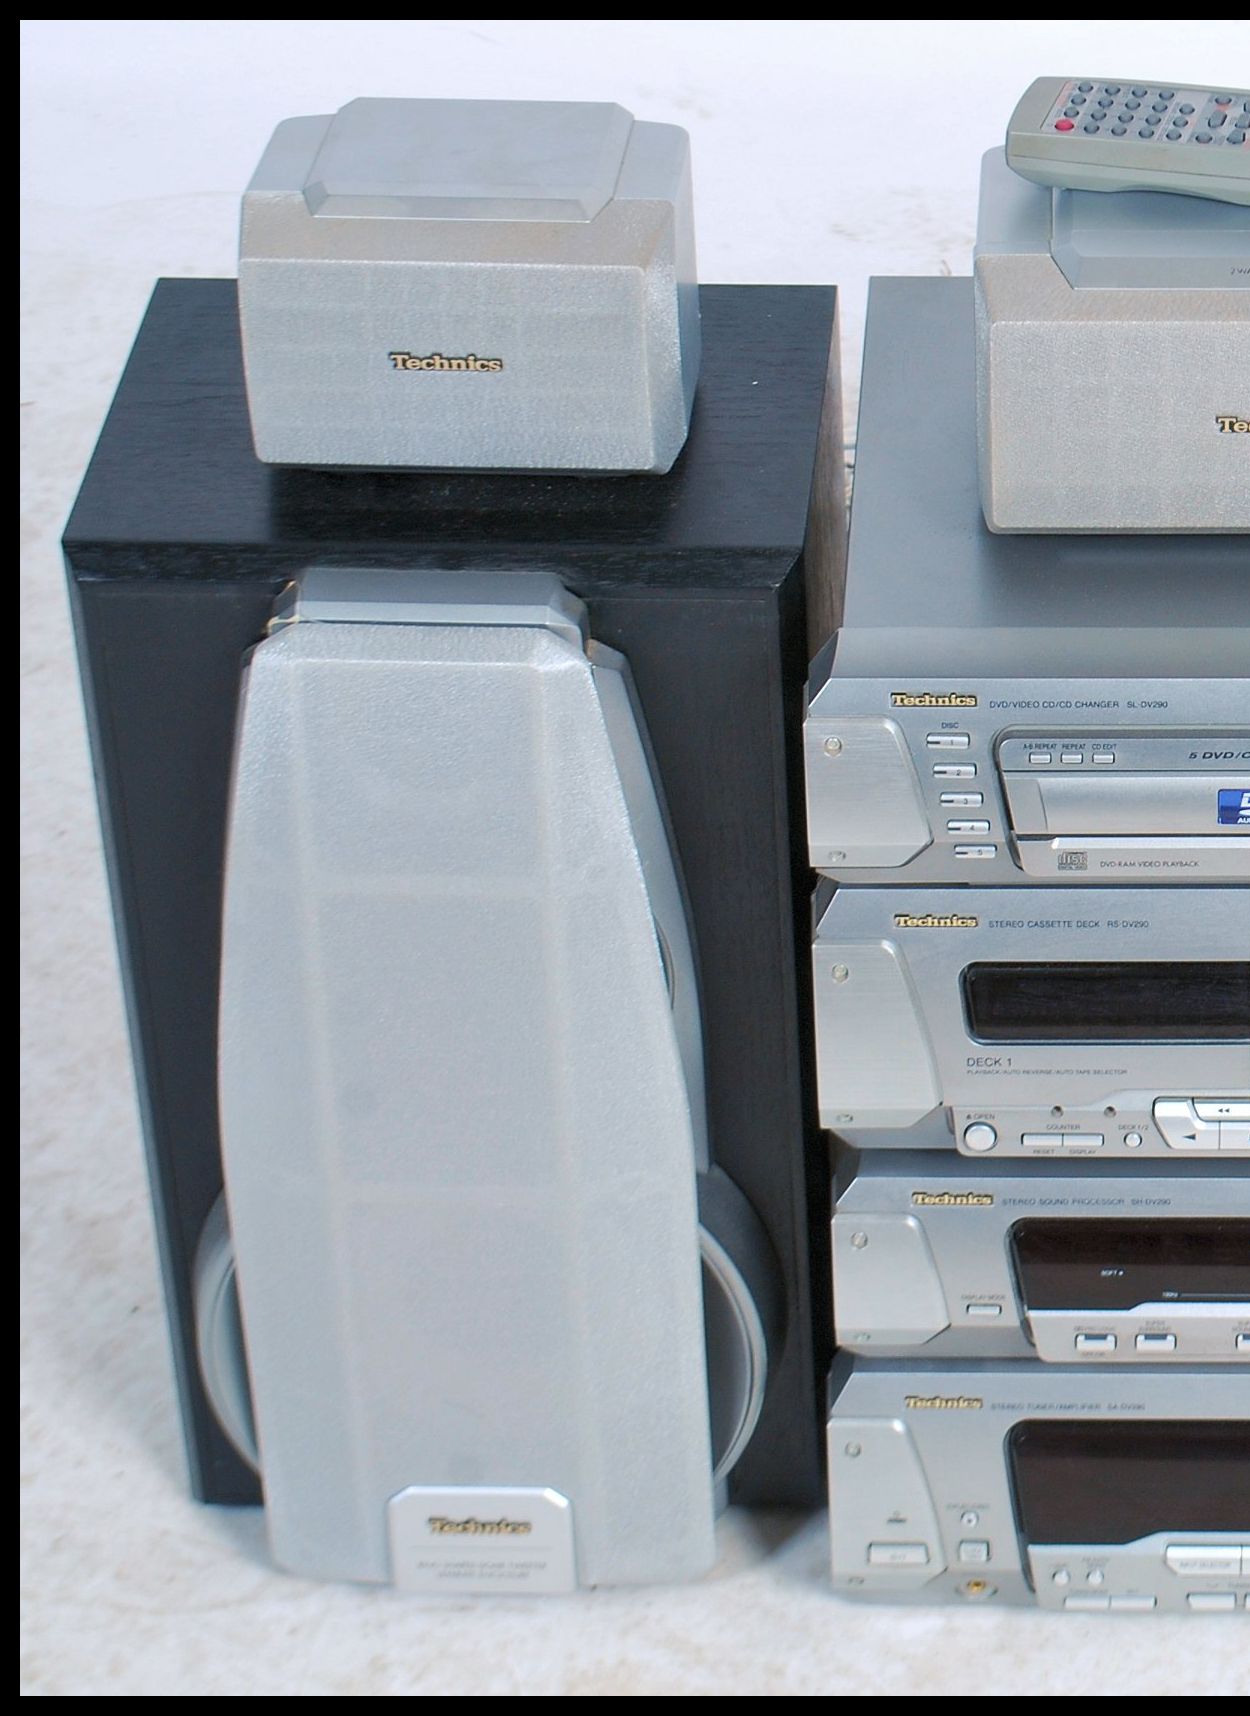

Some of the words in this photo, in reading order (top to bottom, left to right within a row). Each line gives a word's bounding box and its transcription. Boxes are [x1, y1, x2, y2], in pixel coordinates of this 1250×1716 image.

[388, 351, 503, 372] Technics
[890, 692, 978, 708] Technics
[989, 700, 1040, 709] DVD/VIDEO
[1041, 700, 1072, 709] CD/CD
[1074, 700, 1120, 709] CHANGER
[1126, 700, 1169, 709] SL-DV290
[894, 914, 978, 928] Technics
[988, 920, 1024, 928] STEREO
[1027, 920, 1073, 928] CASSETTE
[1076, 920, 1101, 928] DECK
[966, 1057, 1002, 1067] DECK
[912, 1192, 993, 1206] Technics
[904, 1395, 983, 1409] Technics
[428, 1516, 532, 1536] Technics
